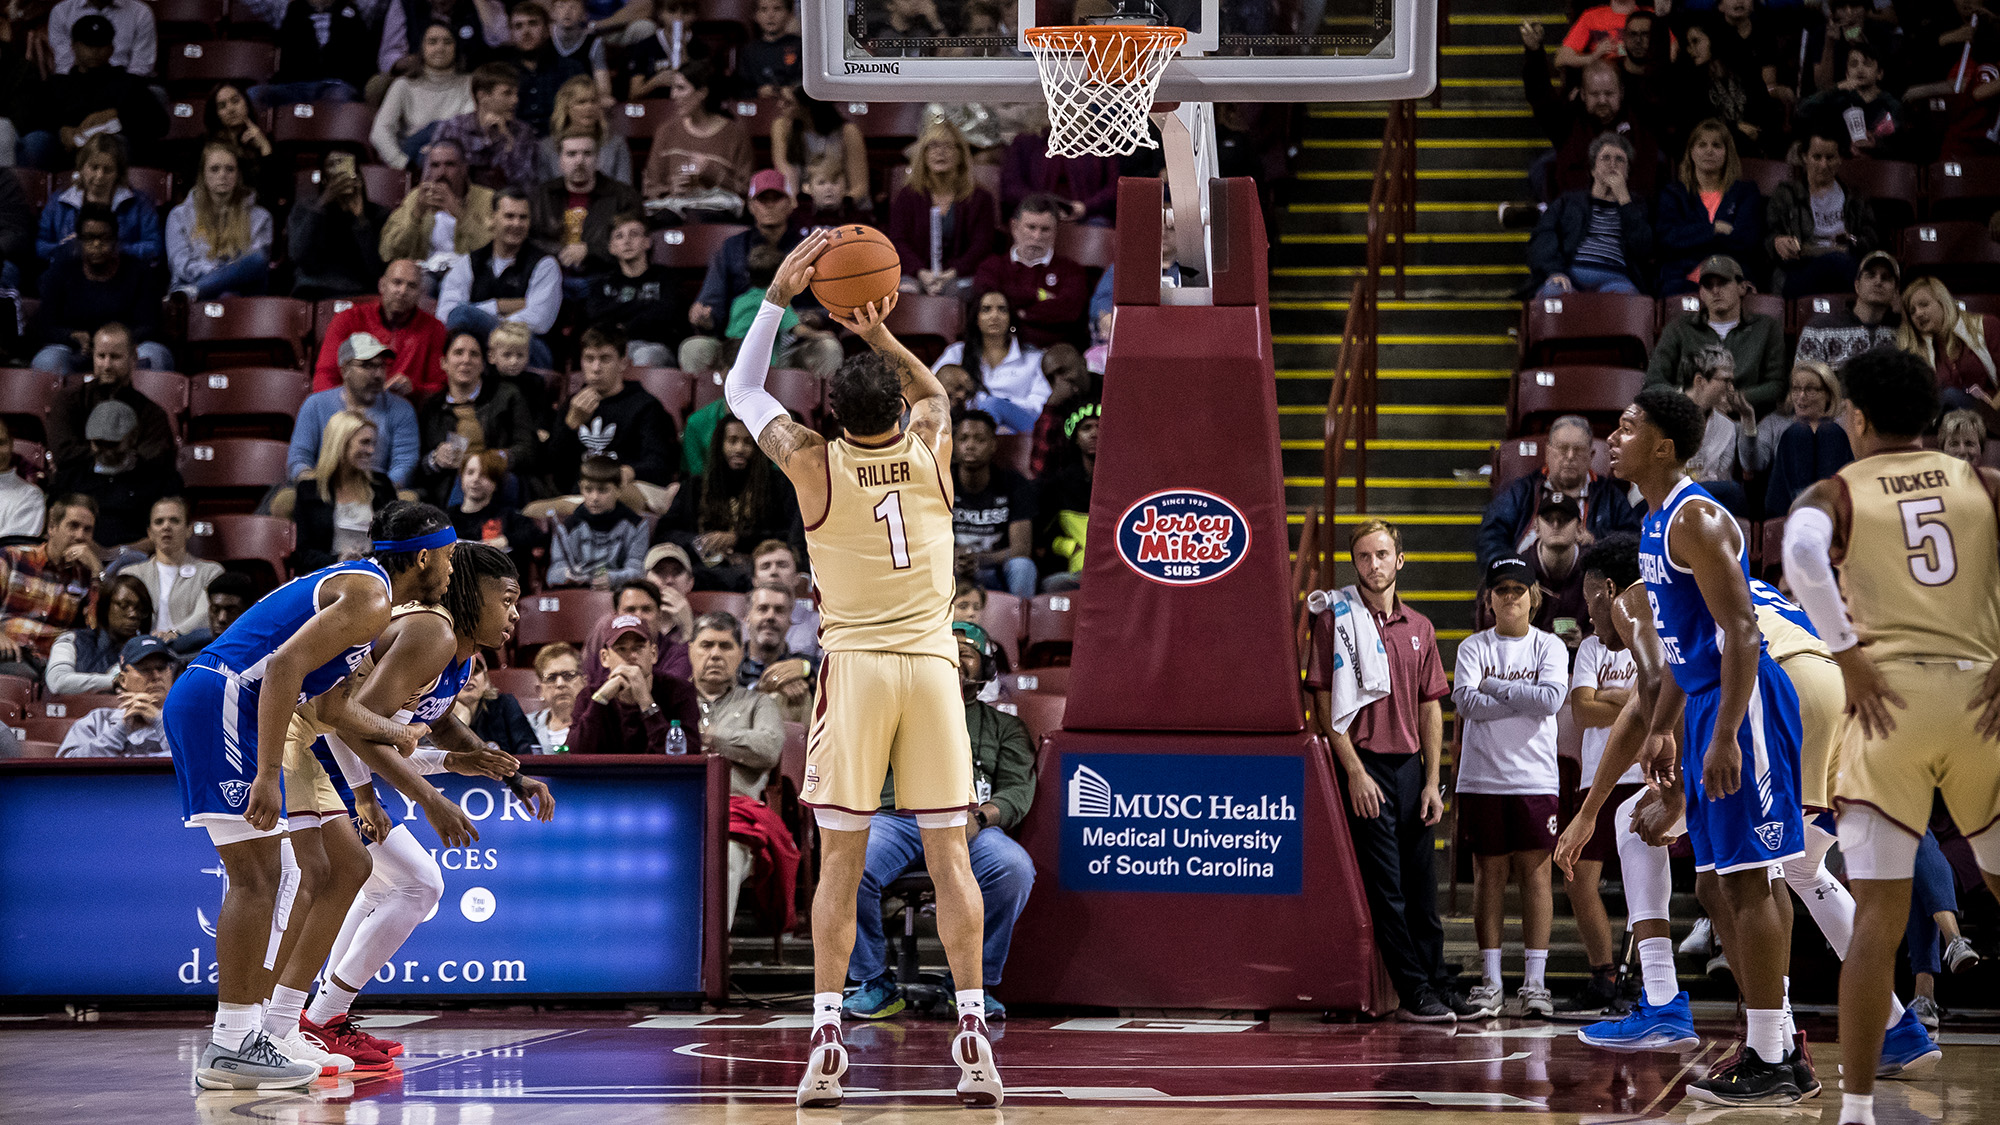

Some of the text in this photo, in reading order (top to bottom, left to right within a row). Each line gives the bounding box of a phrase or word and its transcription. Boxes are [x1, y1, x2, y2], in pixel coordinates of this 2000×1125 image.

[844, 62, 899, 75] SPALDING
[856, 461, 911, 487] RILLER
[1876, 470, 1950, 494] TUCKER
[1162, 498, 1185, 506] SINCE
[873, 490, 911, 570] 1
[1134, 507, 1232, 541] Jersey
[1139, 534, 1231, 562] Mike's
[1897, 496, 1958, 587] 5
[1163, 565, 1200, 576] SUBS
[1113, 794, 1297, 821] MUSC Health
[1083, 827, 1282, 853] Medical University
[1088, 854, 1274, 878] of South Carolina
